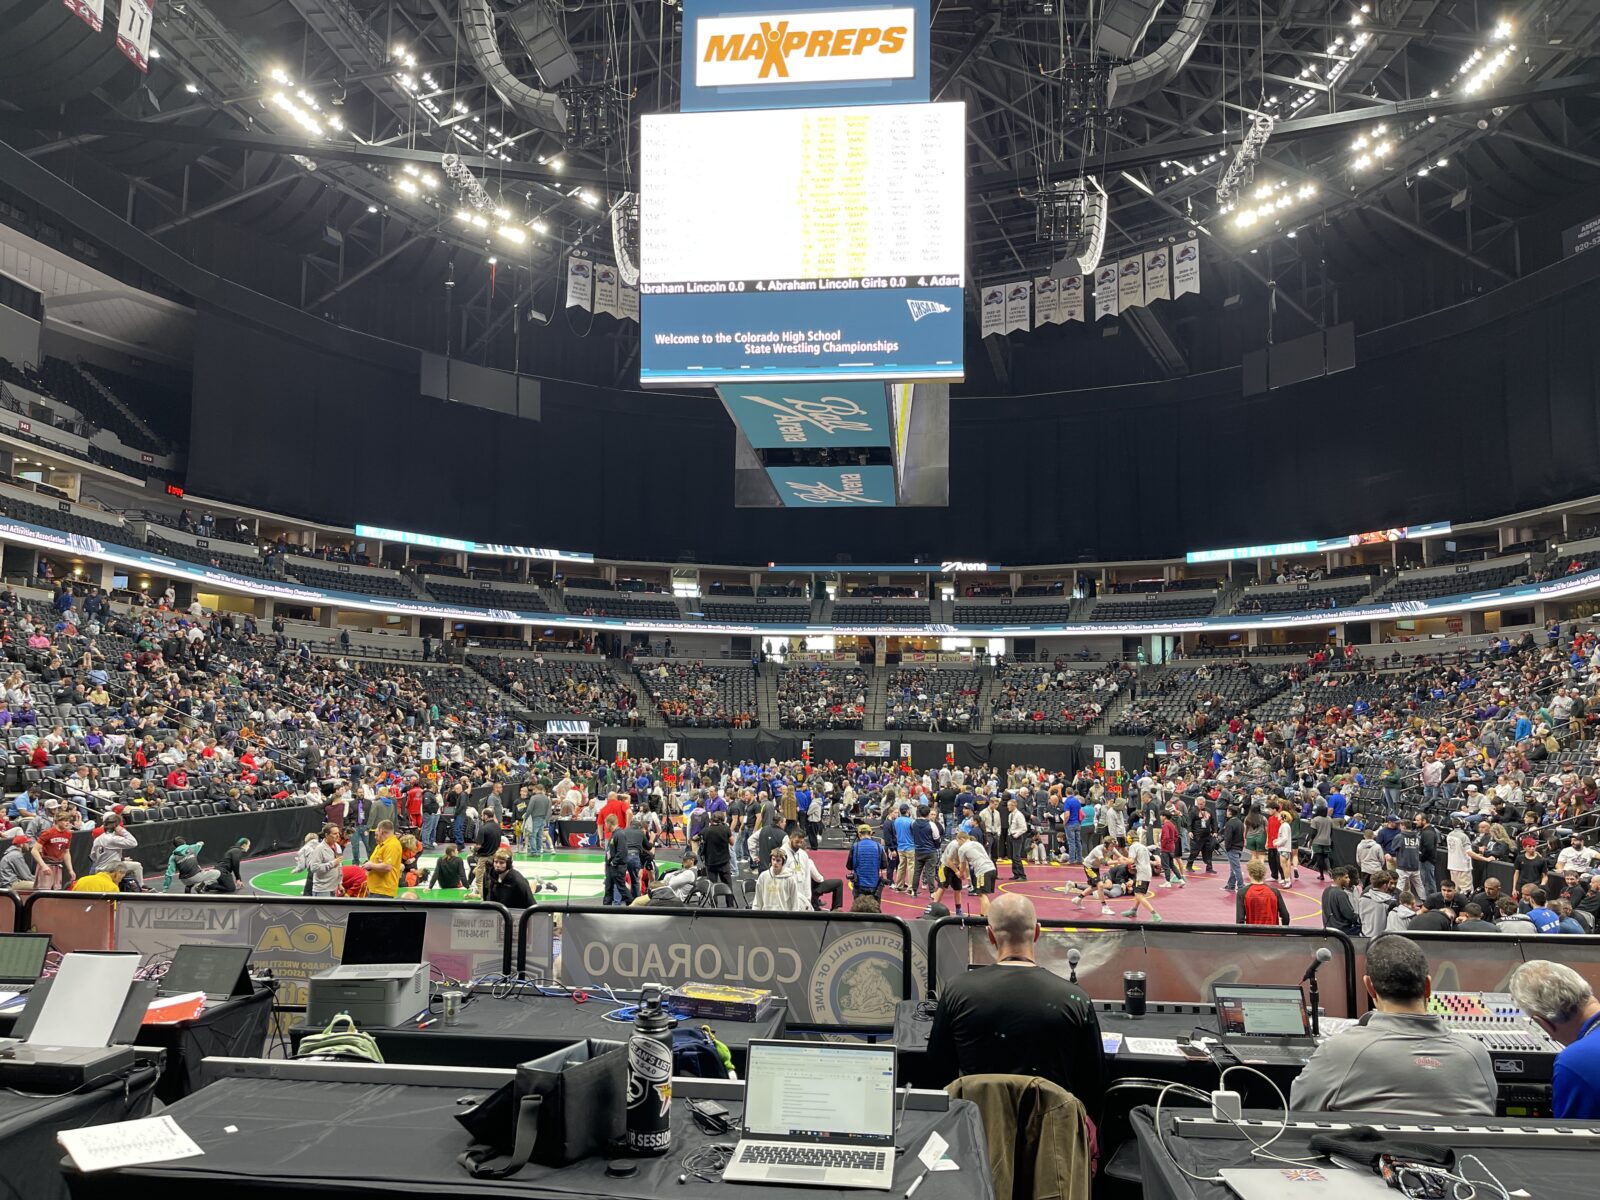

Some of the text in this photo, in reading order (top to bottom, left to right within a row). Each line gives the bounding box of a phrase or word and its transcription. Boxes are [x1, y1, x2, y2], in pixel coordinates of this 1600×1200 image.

[703, 21, 908, 78] MAXPREPS
[686, 282, 726, 292] Lincoln
[728, 282, 744, 292] 0.0
[756, 281, 767, 292] 4.
[768, 280, 809, 290] Abraham
[811, 278, 852, 290] Lincoln
[854, 278, 888, 288] Girls
[890, 277, 906, 288] 0.0
[918, 276, 928, 286] 4.
[655, 330, 840, 344] Welcome to the Colorado High School
[745, 340, 898, 356] State Wrestling Championships
[772, 414, 808, 442] Arena
[36, 532, 66, 544] Association
[955, 562, 987, 571] Arena
[426, 747, 431, 758] 6
[668, 749, 674, 759] 4
[904, 748, 908, 756] 5
[1110, 757, 1116, 769] 3
[1404, 838, 1420, 846] USA
[656, 1060, 672, 1072] LIST
